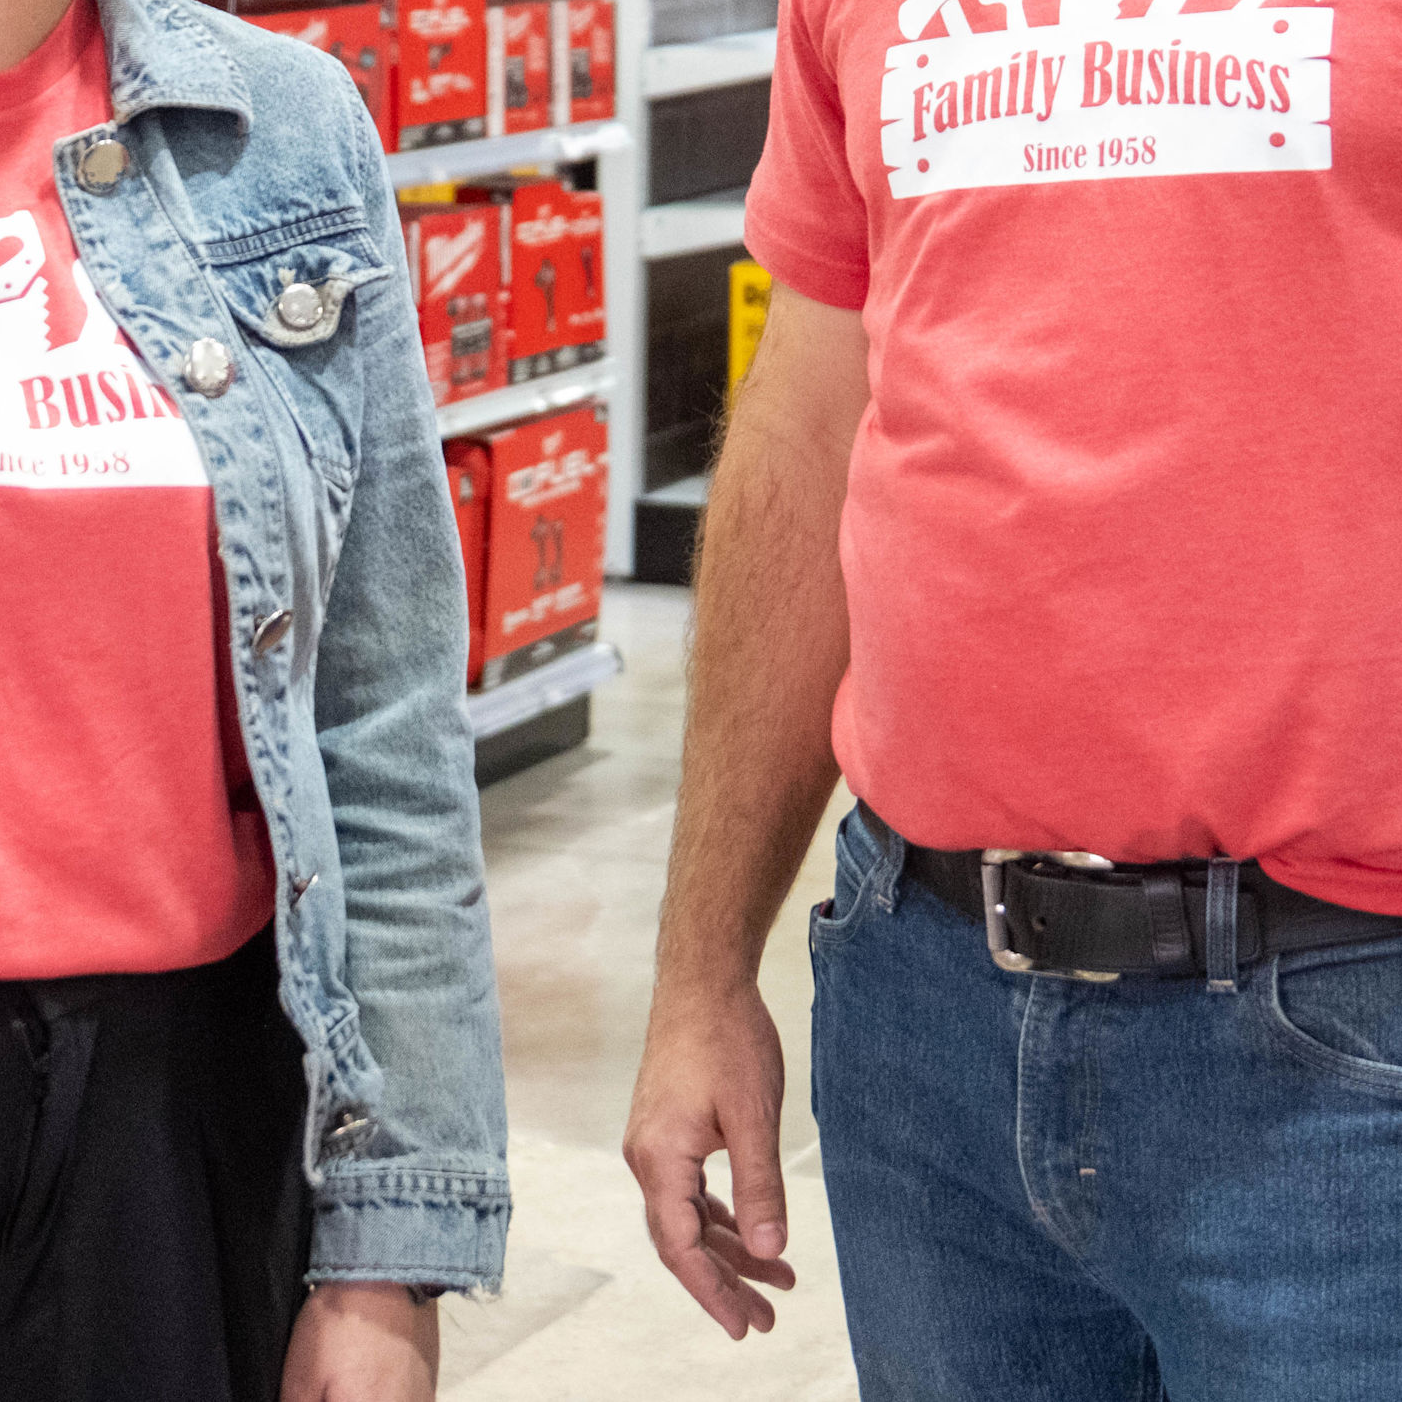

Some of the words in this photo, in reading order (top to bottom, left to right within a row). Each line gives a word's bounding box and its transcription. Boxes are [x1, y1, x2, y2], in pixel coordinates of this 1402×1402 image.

[913, 49, 1066, 143] Family
[1080, 38, 1291, 114] Business
[1024, 142, 1087, 173] Since
[1096, 136, 1157, 167] 1958
[19, 364, 185, 430] Busin
